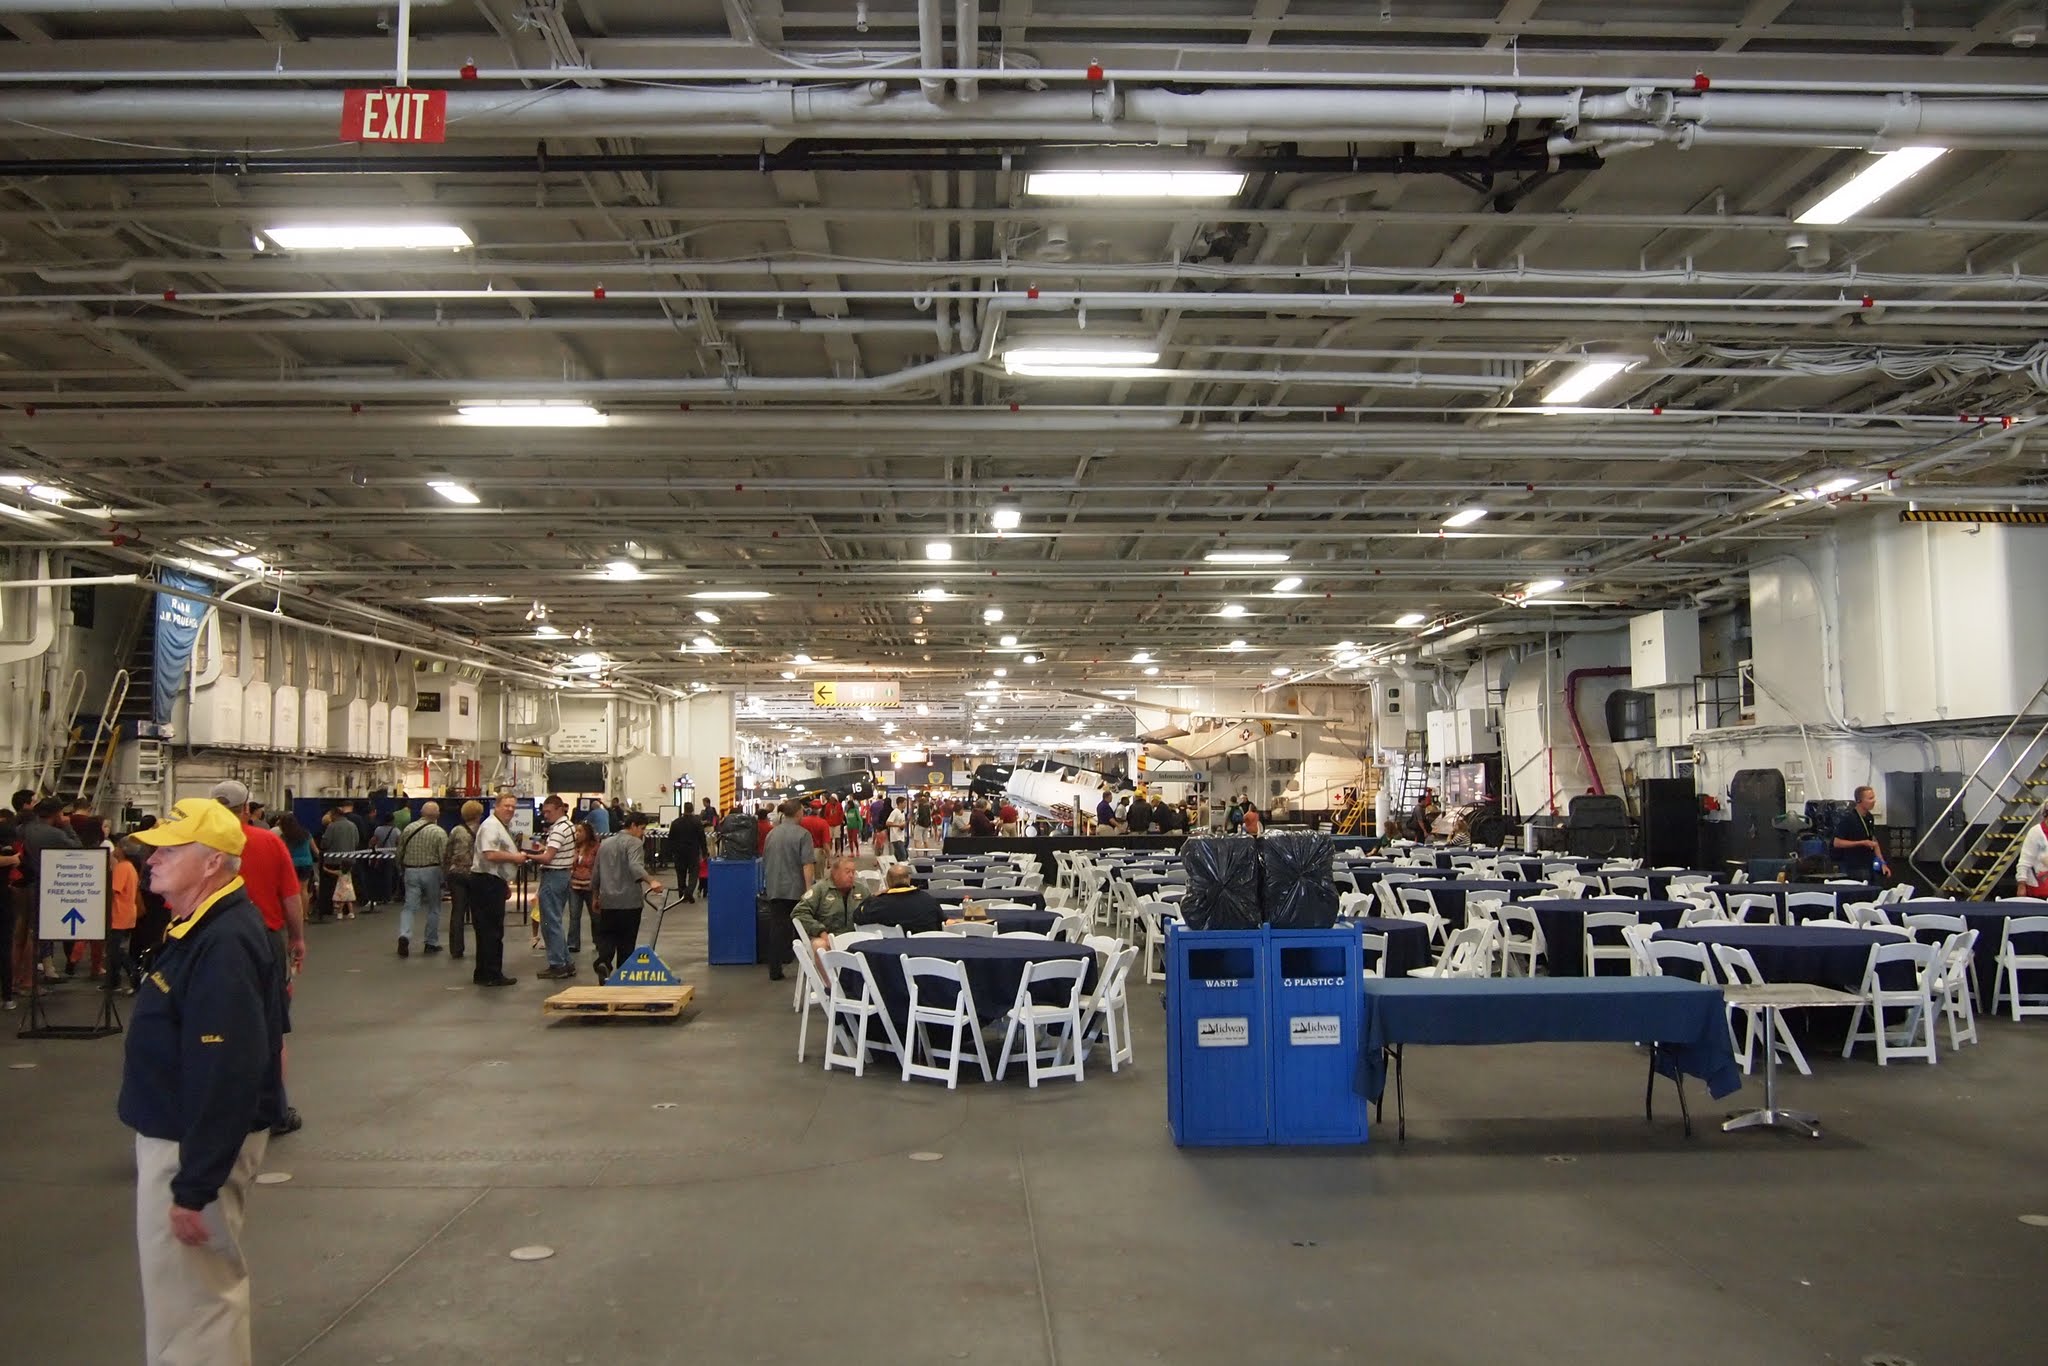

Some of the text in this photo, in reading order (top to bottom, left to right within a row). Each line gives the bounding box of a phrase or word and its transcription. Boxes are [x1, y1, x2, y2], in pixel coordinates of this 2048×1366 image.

[362, 93, 429, 139] EXIT
[851, 782, 863, 794] 16
[620, 970, 668, 983] FANTAIL
[1294, 978, 1334, 986] PLASTIC
[1205, 980, 1239, 988] WASTE
[1208, 1022, 1247, 1036] Midway
[1300, 1020, 1339, 1034] Midway
